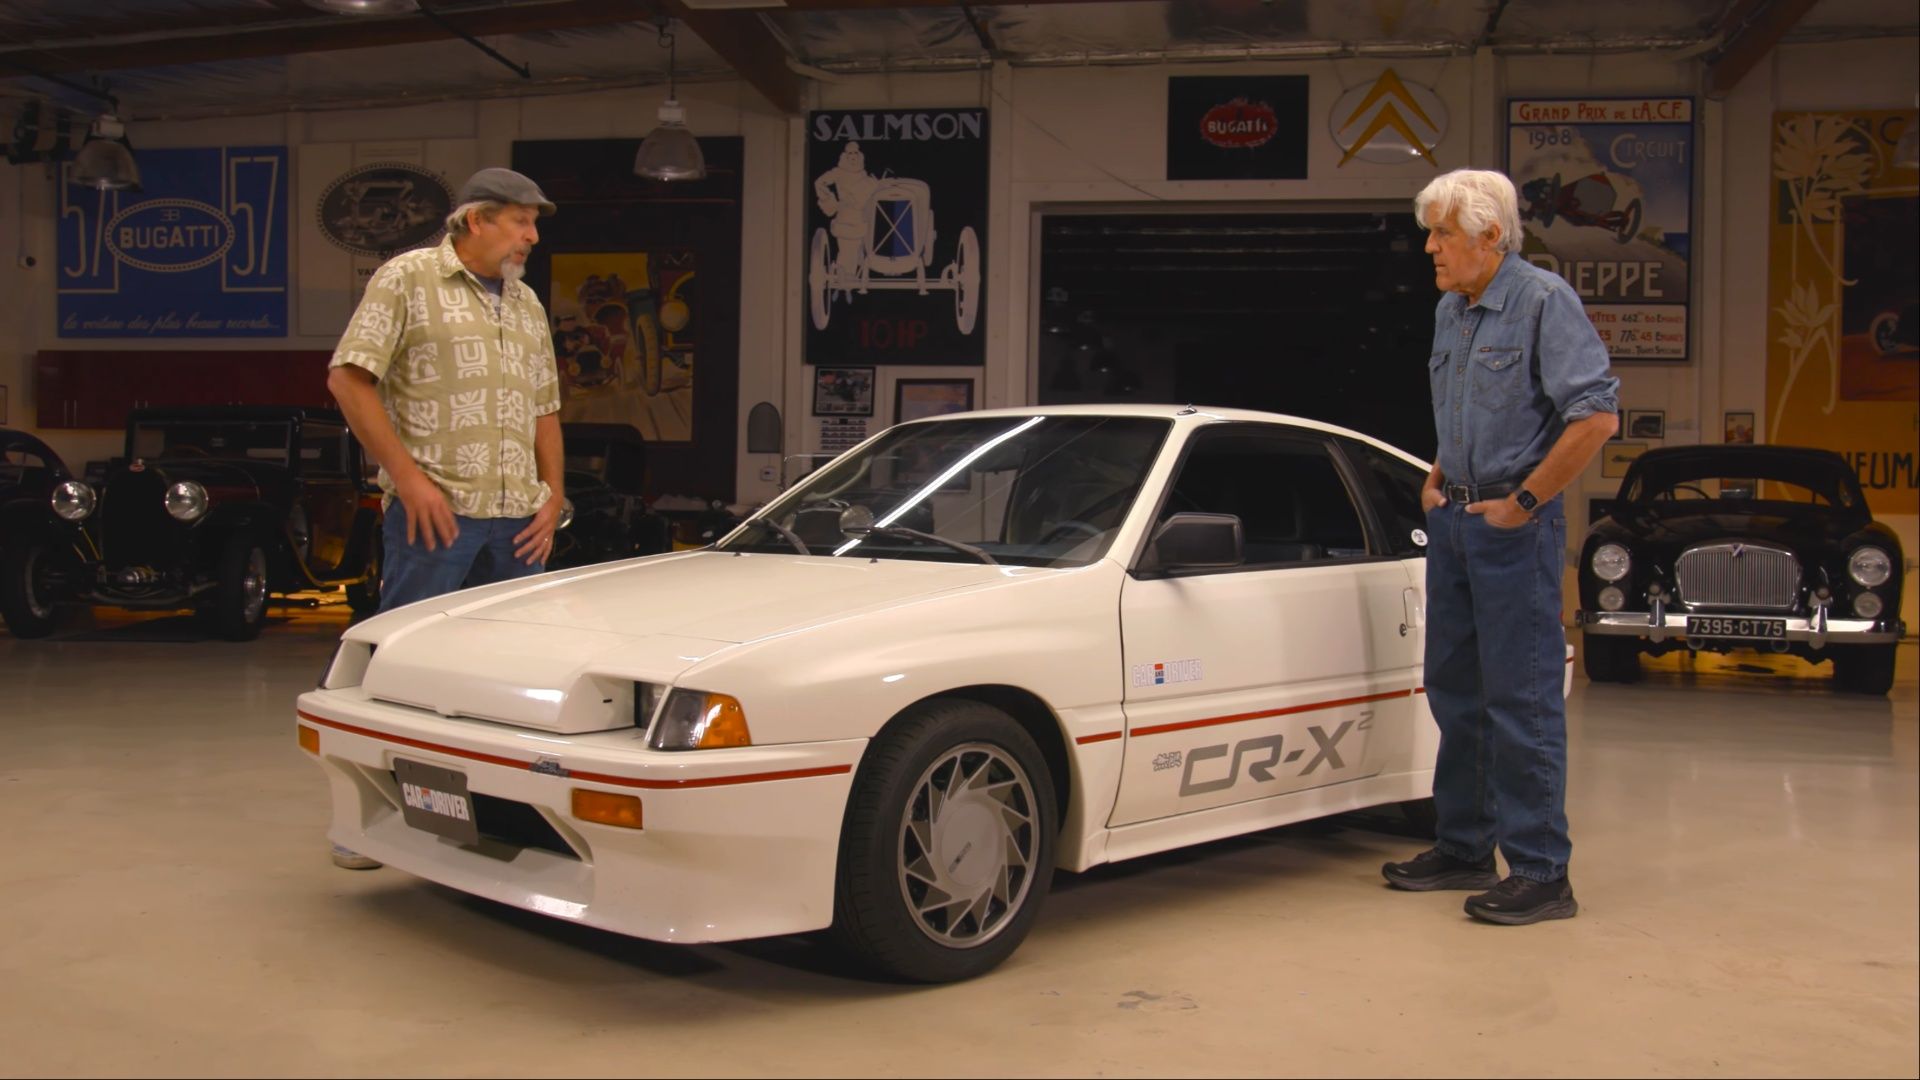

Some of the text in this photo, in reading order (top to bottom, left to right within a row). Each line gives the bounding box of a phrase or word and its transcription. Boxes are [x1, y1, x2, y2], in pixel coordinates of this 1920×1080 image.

[813, 112, 984, 142] SALMSON
[1519, 103, 1570, 121] GRAND
[1578, 102, 1607, 120] PRIX
[1610, 132, 1685, 169] CIRCUIT
[229, 156, 279, 276] 57
[119, 225, 219, 249] BUGATTI
[402, 782, 470, 821] CAR DRIVER
